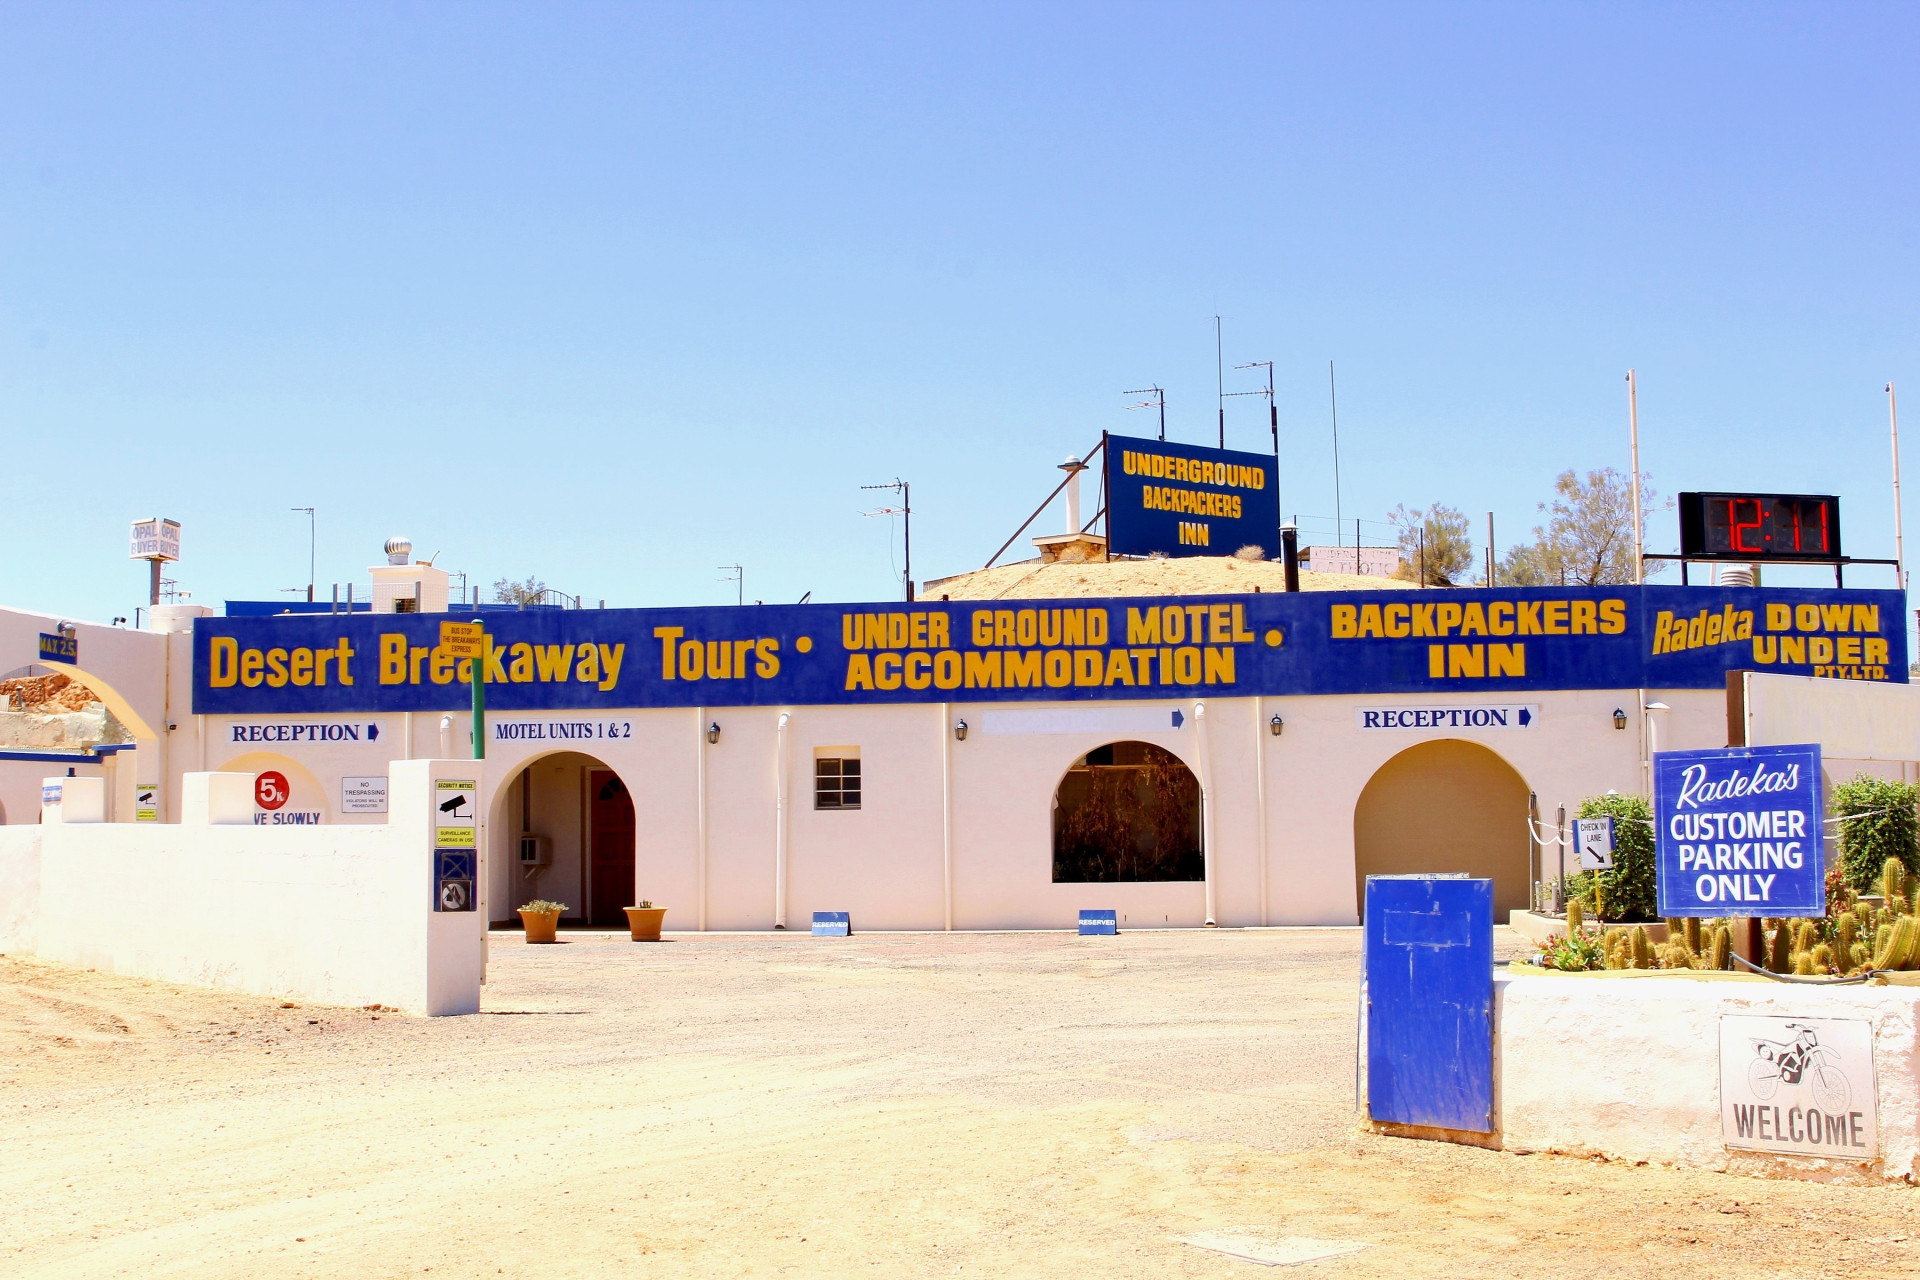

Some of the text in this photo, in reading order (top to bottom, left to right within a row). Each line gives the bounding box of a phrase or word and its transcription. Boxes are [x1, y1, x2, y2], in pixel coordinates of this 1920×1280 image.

[1123, 450, 1265, 490] UNDERGROUND
[1143, 485, 1242, 519] BACKPACKERS
[133, 525, 157, 539] OPAL
[161, 525, 179, 541] OPAL
[1178, 521, 1210, 547] INN
[1729, 499, 1828, 552] 12:11
[131, 540, 158, 554] BUYER
[160, 540, 179, 558] BUYER
[461, 627, 473, 635] STOP
[842, 604, 1255, 650] UNDER GROUND MOTEL
[1330, 599, 1626, 639] BACKPACKERS
[1652, 604, 1754, 655] Radeka
[1766, 603, 1881, 632] DOWN
[451, 645, 472, 653] EXPRESS
[452, 636, 481, 644] BREAKAWAYS
[1752, 636, 1889, 665] UNDER
[209, 626, 779, 691] Desert Breakaway Tours
[845, 647, 1236, 690] ACCOMMODATION
[1429, 643, 1525, 678] INN
[496, 722, 631, 739] MOTEL UNITS 1 & 2
[1363, 709, 1508, 728] RECEPTION
[232, 725, 360, 742] RECEPTION
[1676, 762, 1799, 809] Radeka's
[273, 812, 321, 825] SLOWLY
[1580, 822, 1607, 831] CHECK IN
[1670, 810, 1806, 841] CUSTOMER
[1586, 834, 1602, 842] LANE
[1678, 842, 1804, 871] PARKING
[1695, 874, 1776, 901] ONLY
[1733, 1103, 1866, 1147] WELCOME
